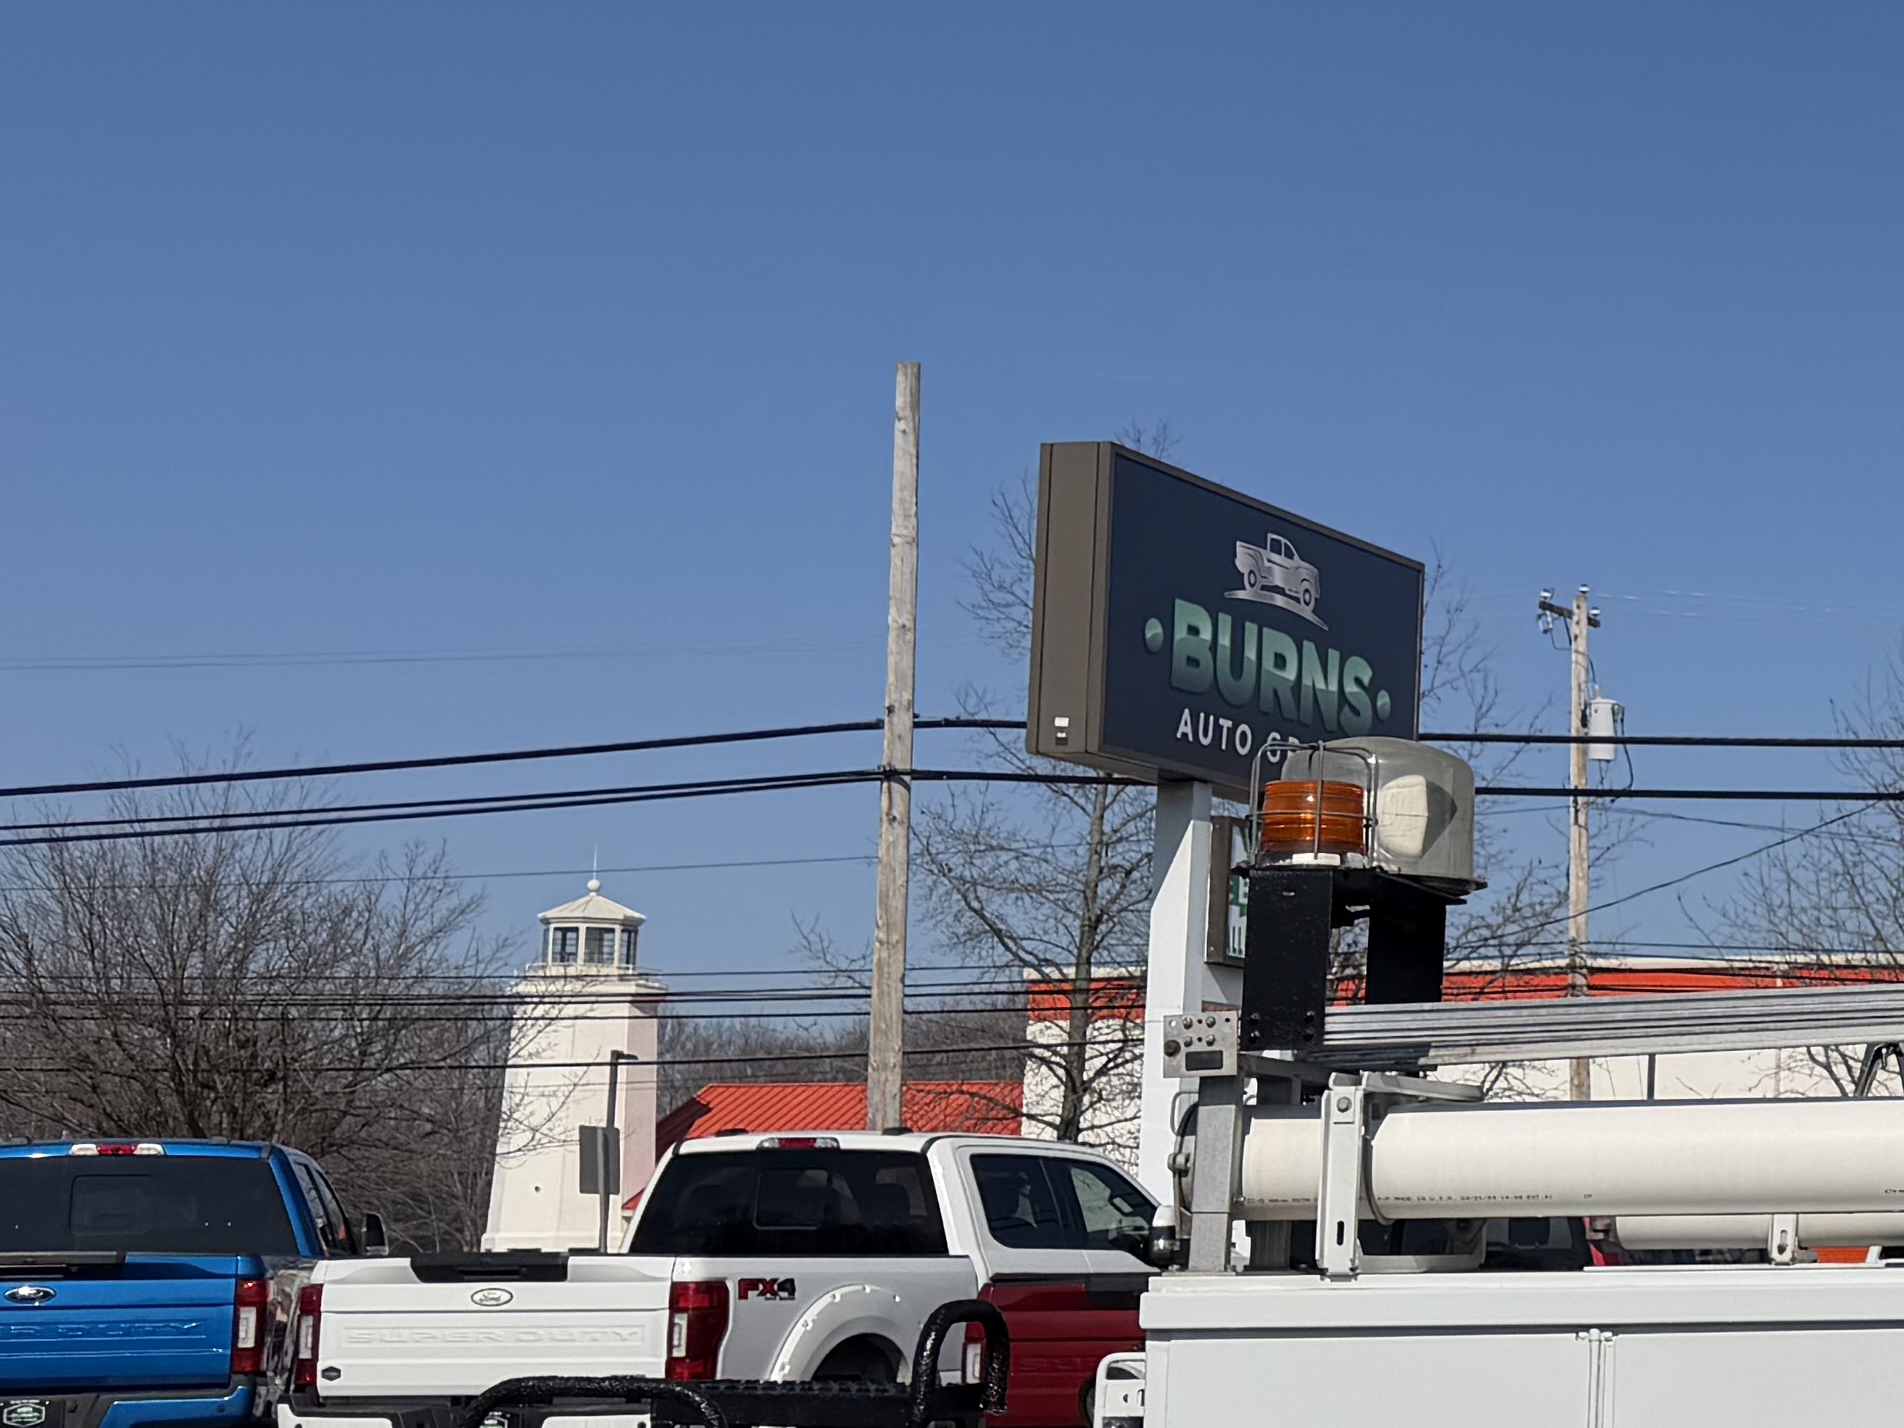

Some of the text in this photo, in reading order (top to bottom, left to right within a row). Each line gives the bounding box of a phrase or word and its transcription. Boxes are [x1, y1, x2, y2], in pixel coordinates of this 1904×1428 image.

[1169, 597, 1373, 736] BURNS
[1175, 707, 1253, 756] AUTO
[738, 1277, 796, 1300] FX4
[344, 1327, 642, 1344] SUPER DUTY
